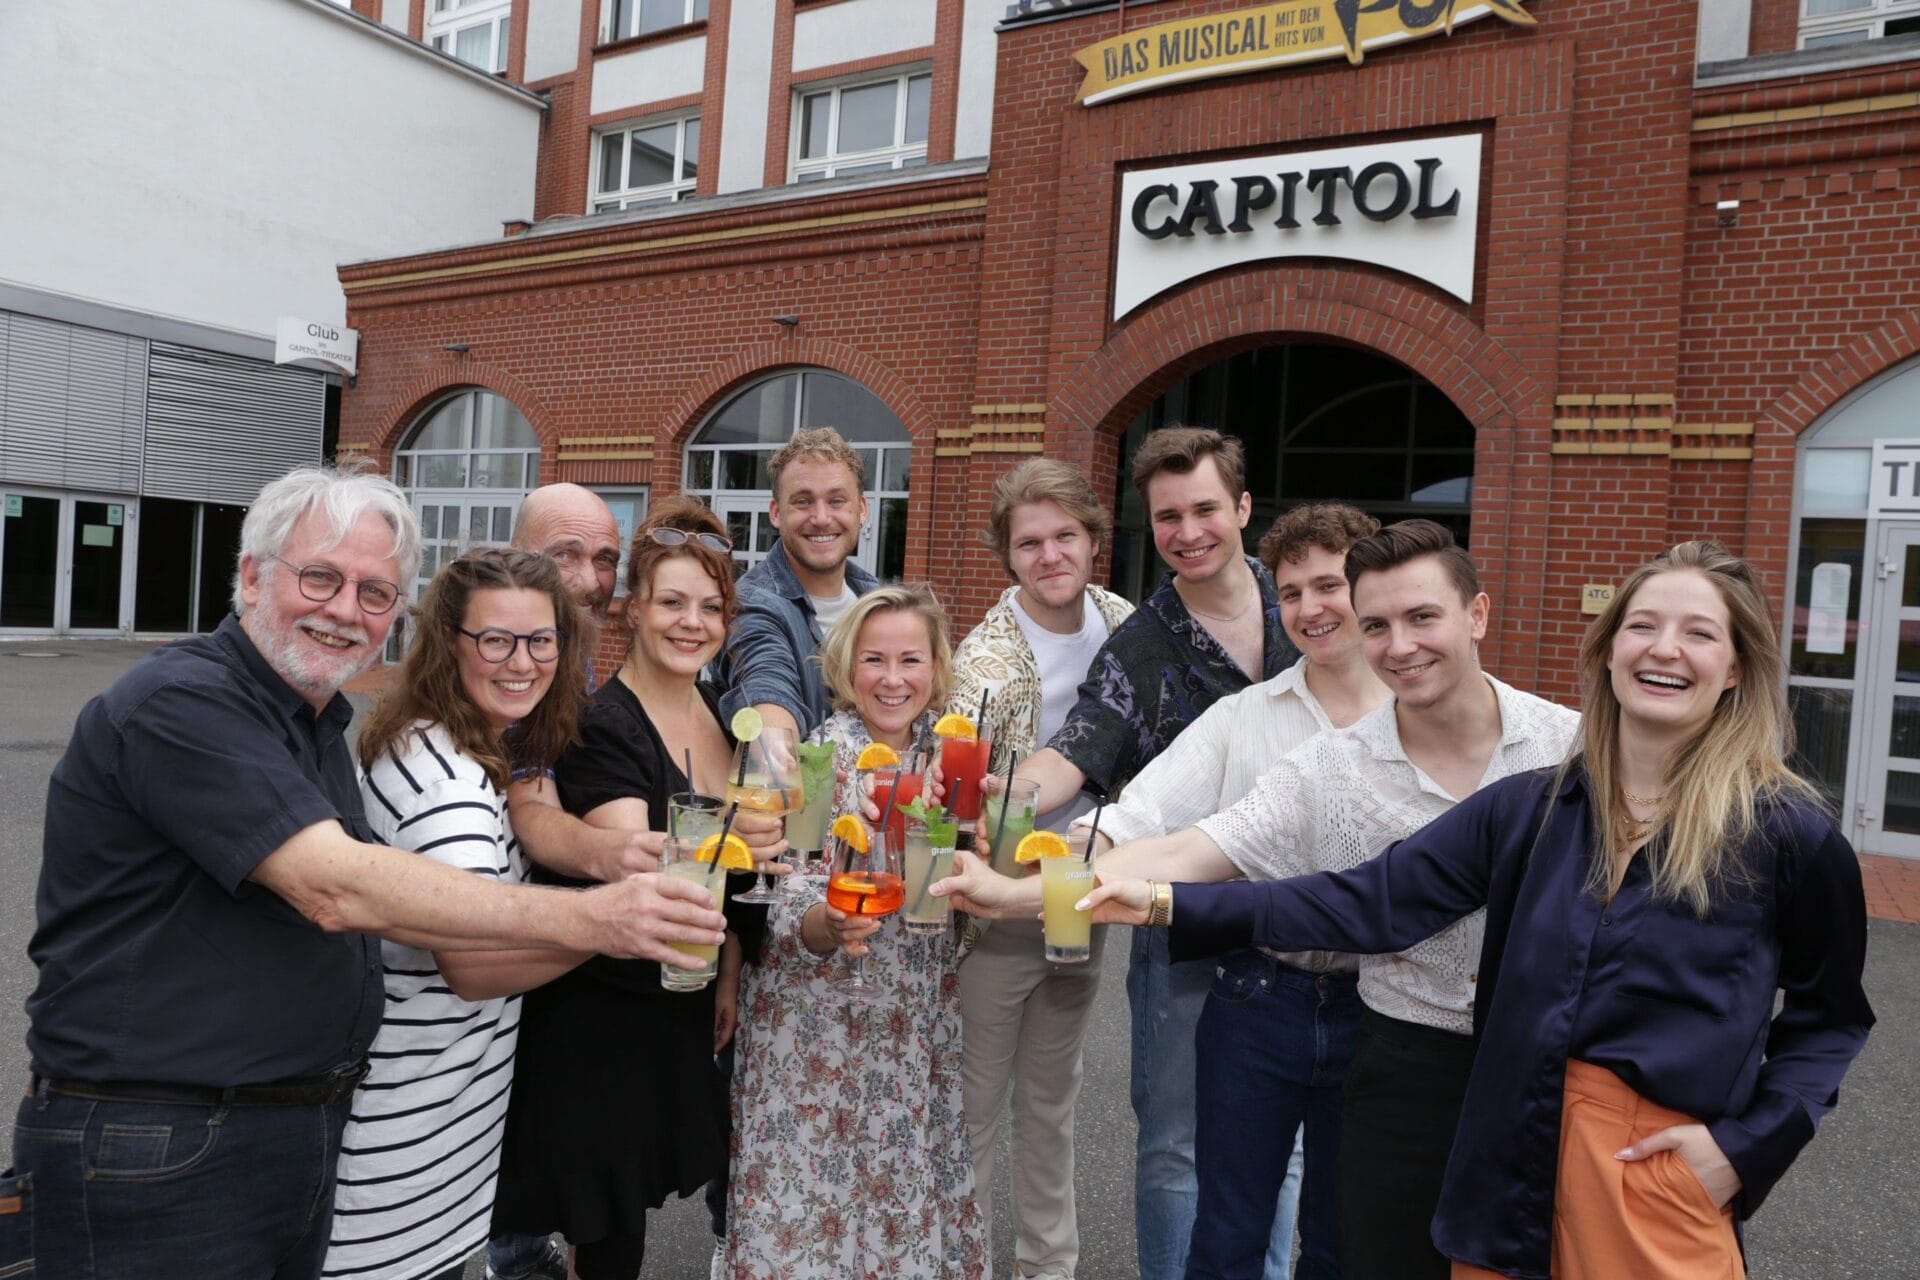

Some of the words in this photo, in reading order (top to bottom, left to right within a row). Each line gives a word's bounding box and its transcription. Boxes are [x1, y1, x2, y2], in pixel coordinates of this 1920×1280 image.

[1276, 10, 1296, 28] MIT
[1300, 6, 1320, 24] DEN
[1274, 30, 1299, 48] HITS
[1302, 26, 1325, 43] VON
[1104, 38, 1150, 82] DAS
[1158, 15, 1270, 68] MUSICAL
[1131, 158, 1461, 240] CAPITOL
[307, 323, 339, 341] Club
